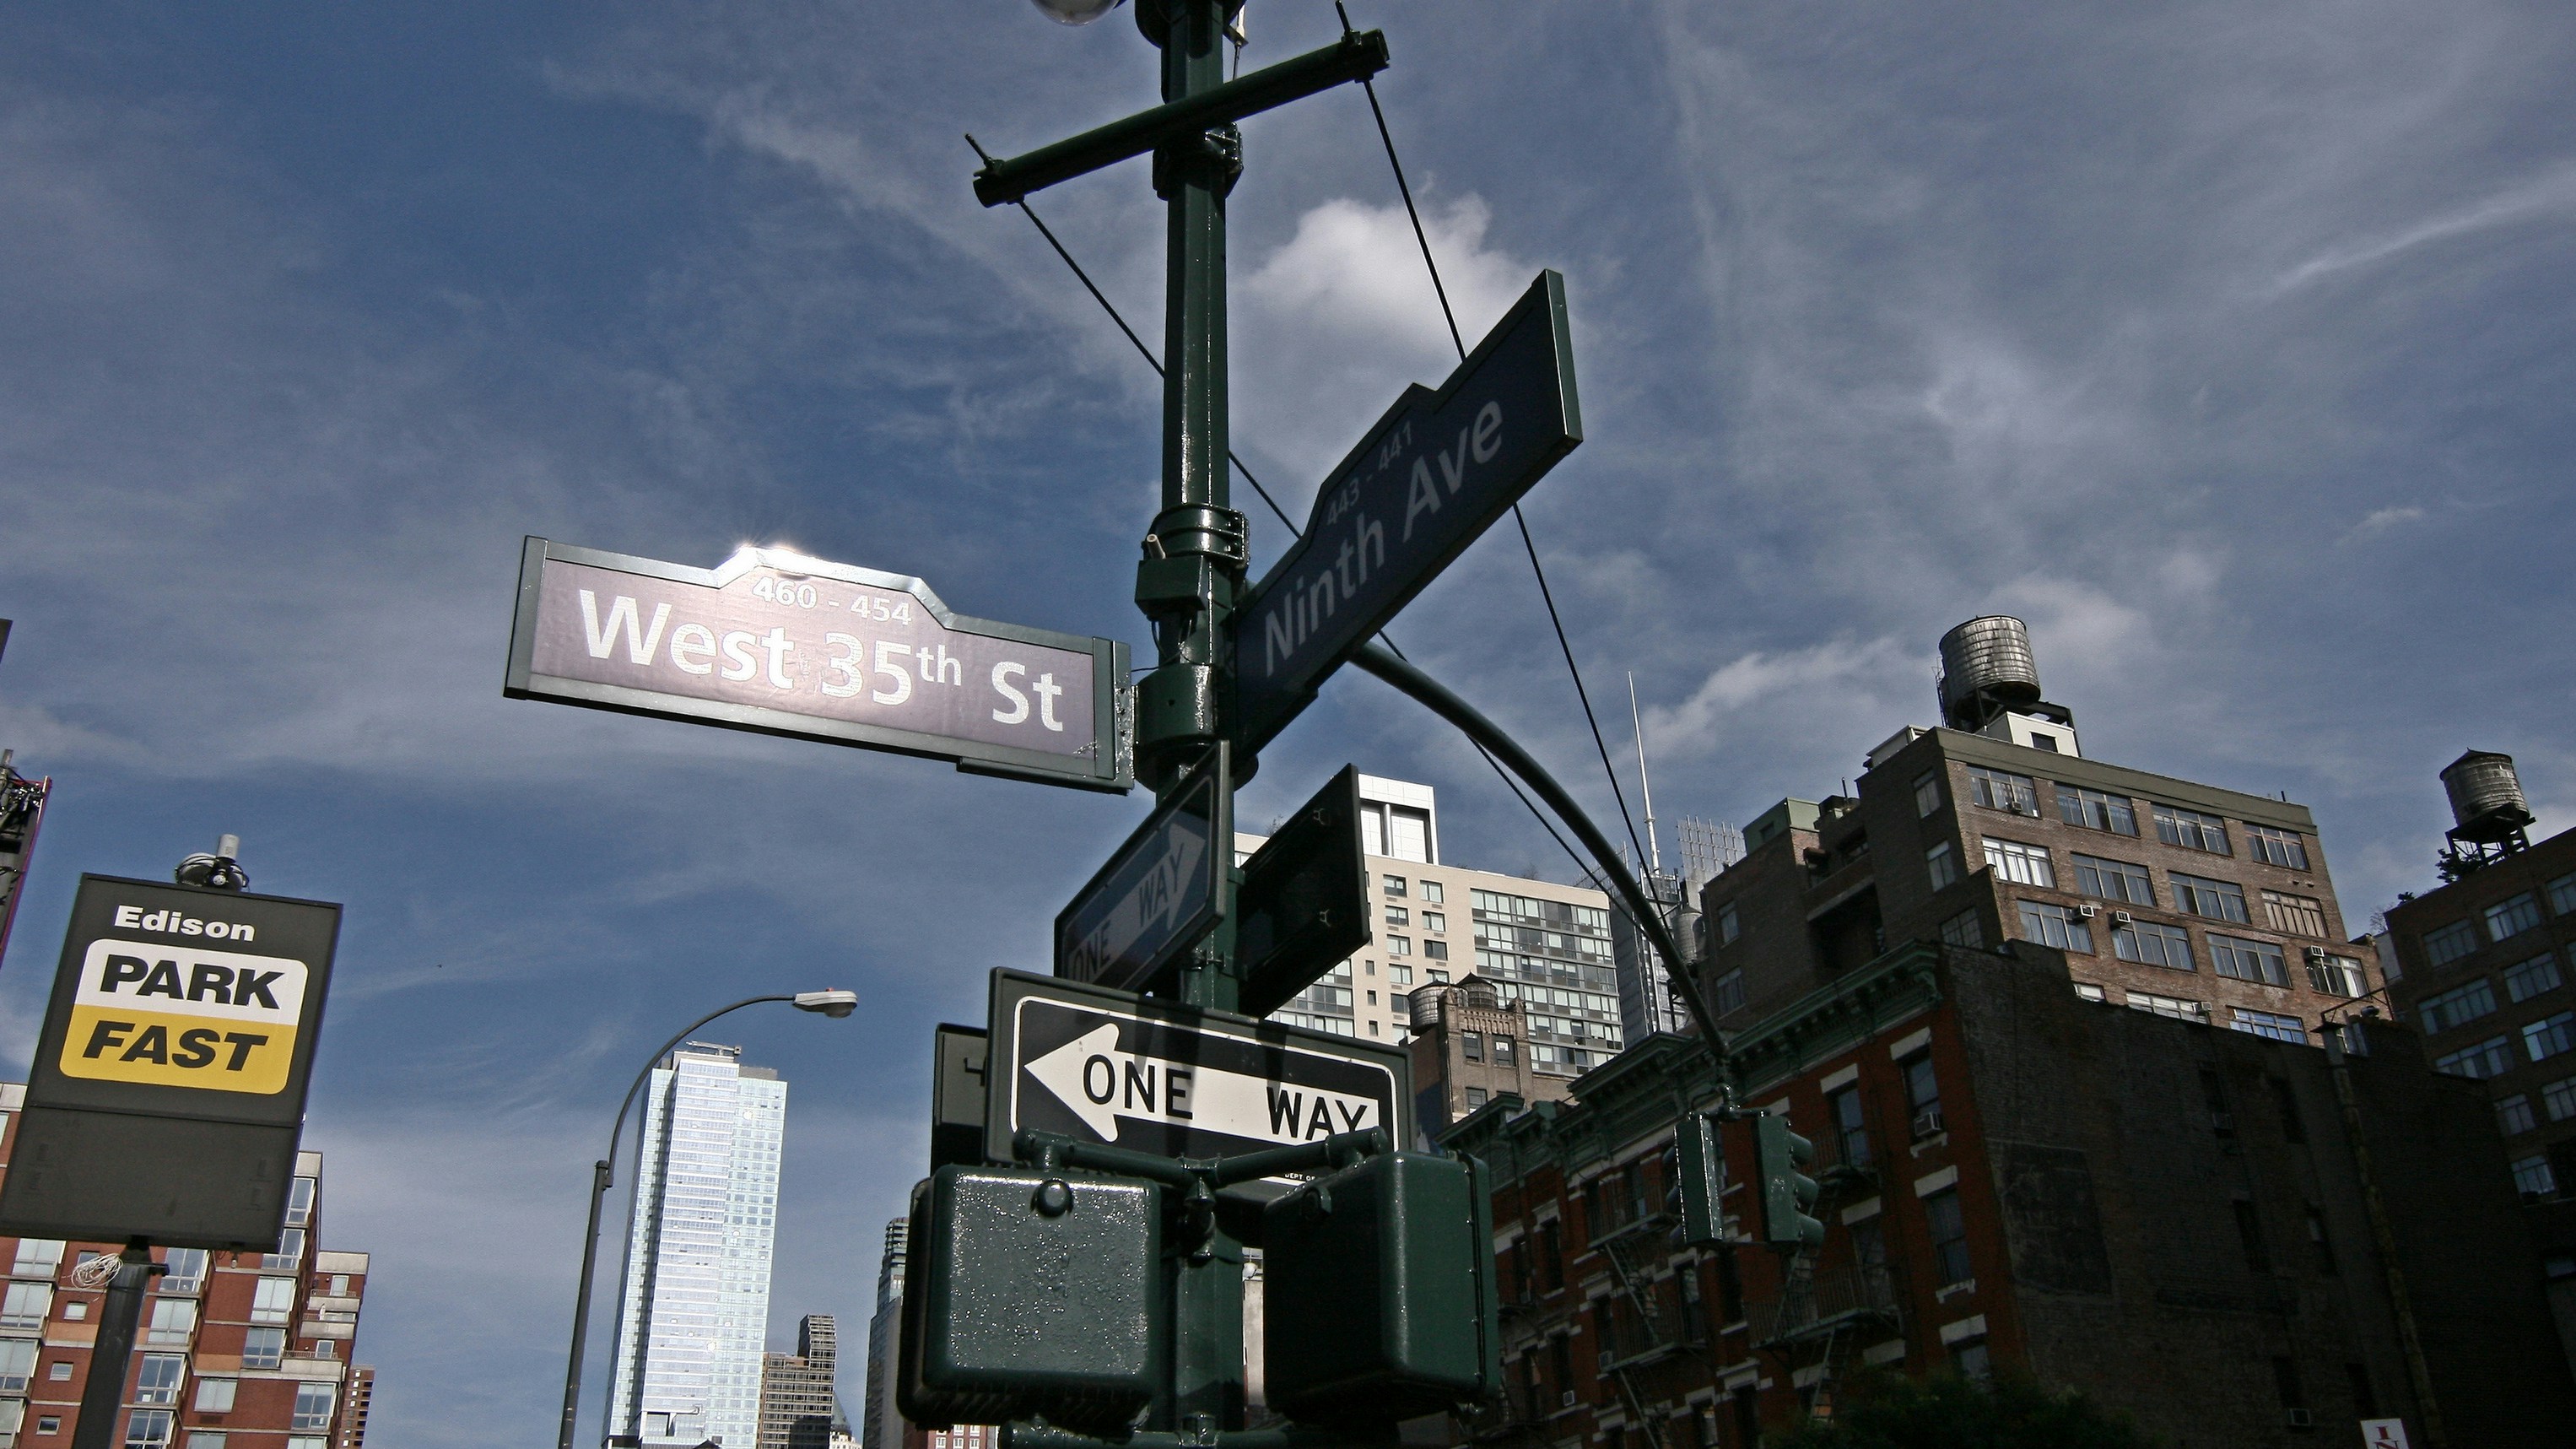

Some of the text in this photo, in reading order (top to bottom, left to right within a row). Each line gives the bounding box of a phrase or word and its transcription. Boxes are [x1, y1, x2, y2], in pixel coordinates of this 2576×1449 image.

[1327, 478, 1361, 527] 443
[1378, 420, 1412, 473] 441
[1266, 399, 1503, 678] Ninth Ave
[751, 576, 818, 610] 460
[851, 595, 914, 626] 454
[579, 588, 1064, 733] West 35th St
[113, 905, 256, 942] Edison
[1072, 841, 1185, 983] ONE WAY
[100, 954, 285, 1010] PARK
[82, 1019, 269, 1072] FAST
[1083, 1054, 1369, 1141] ONE WAY
